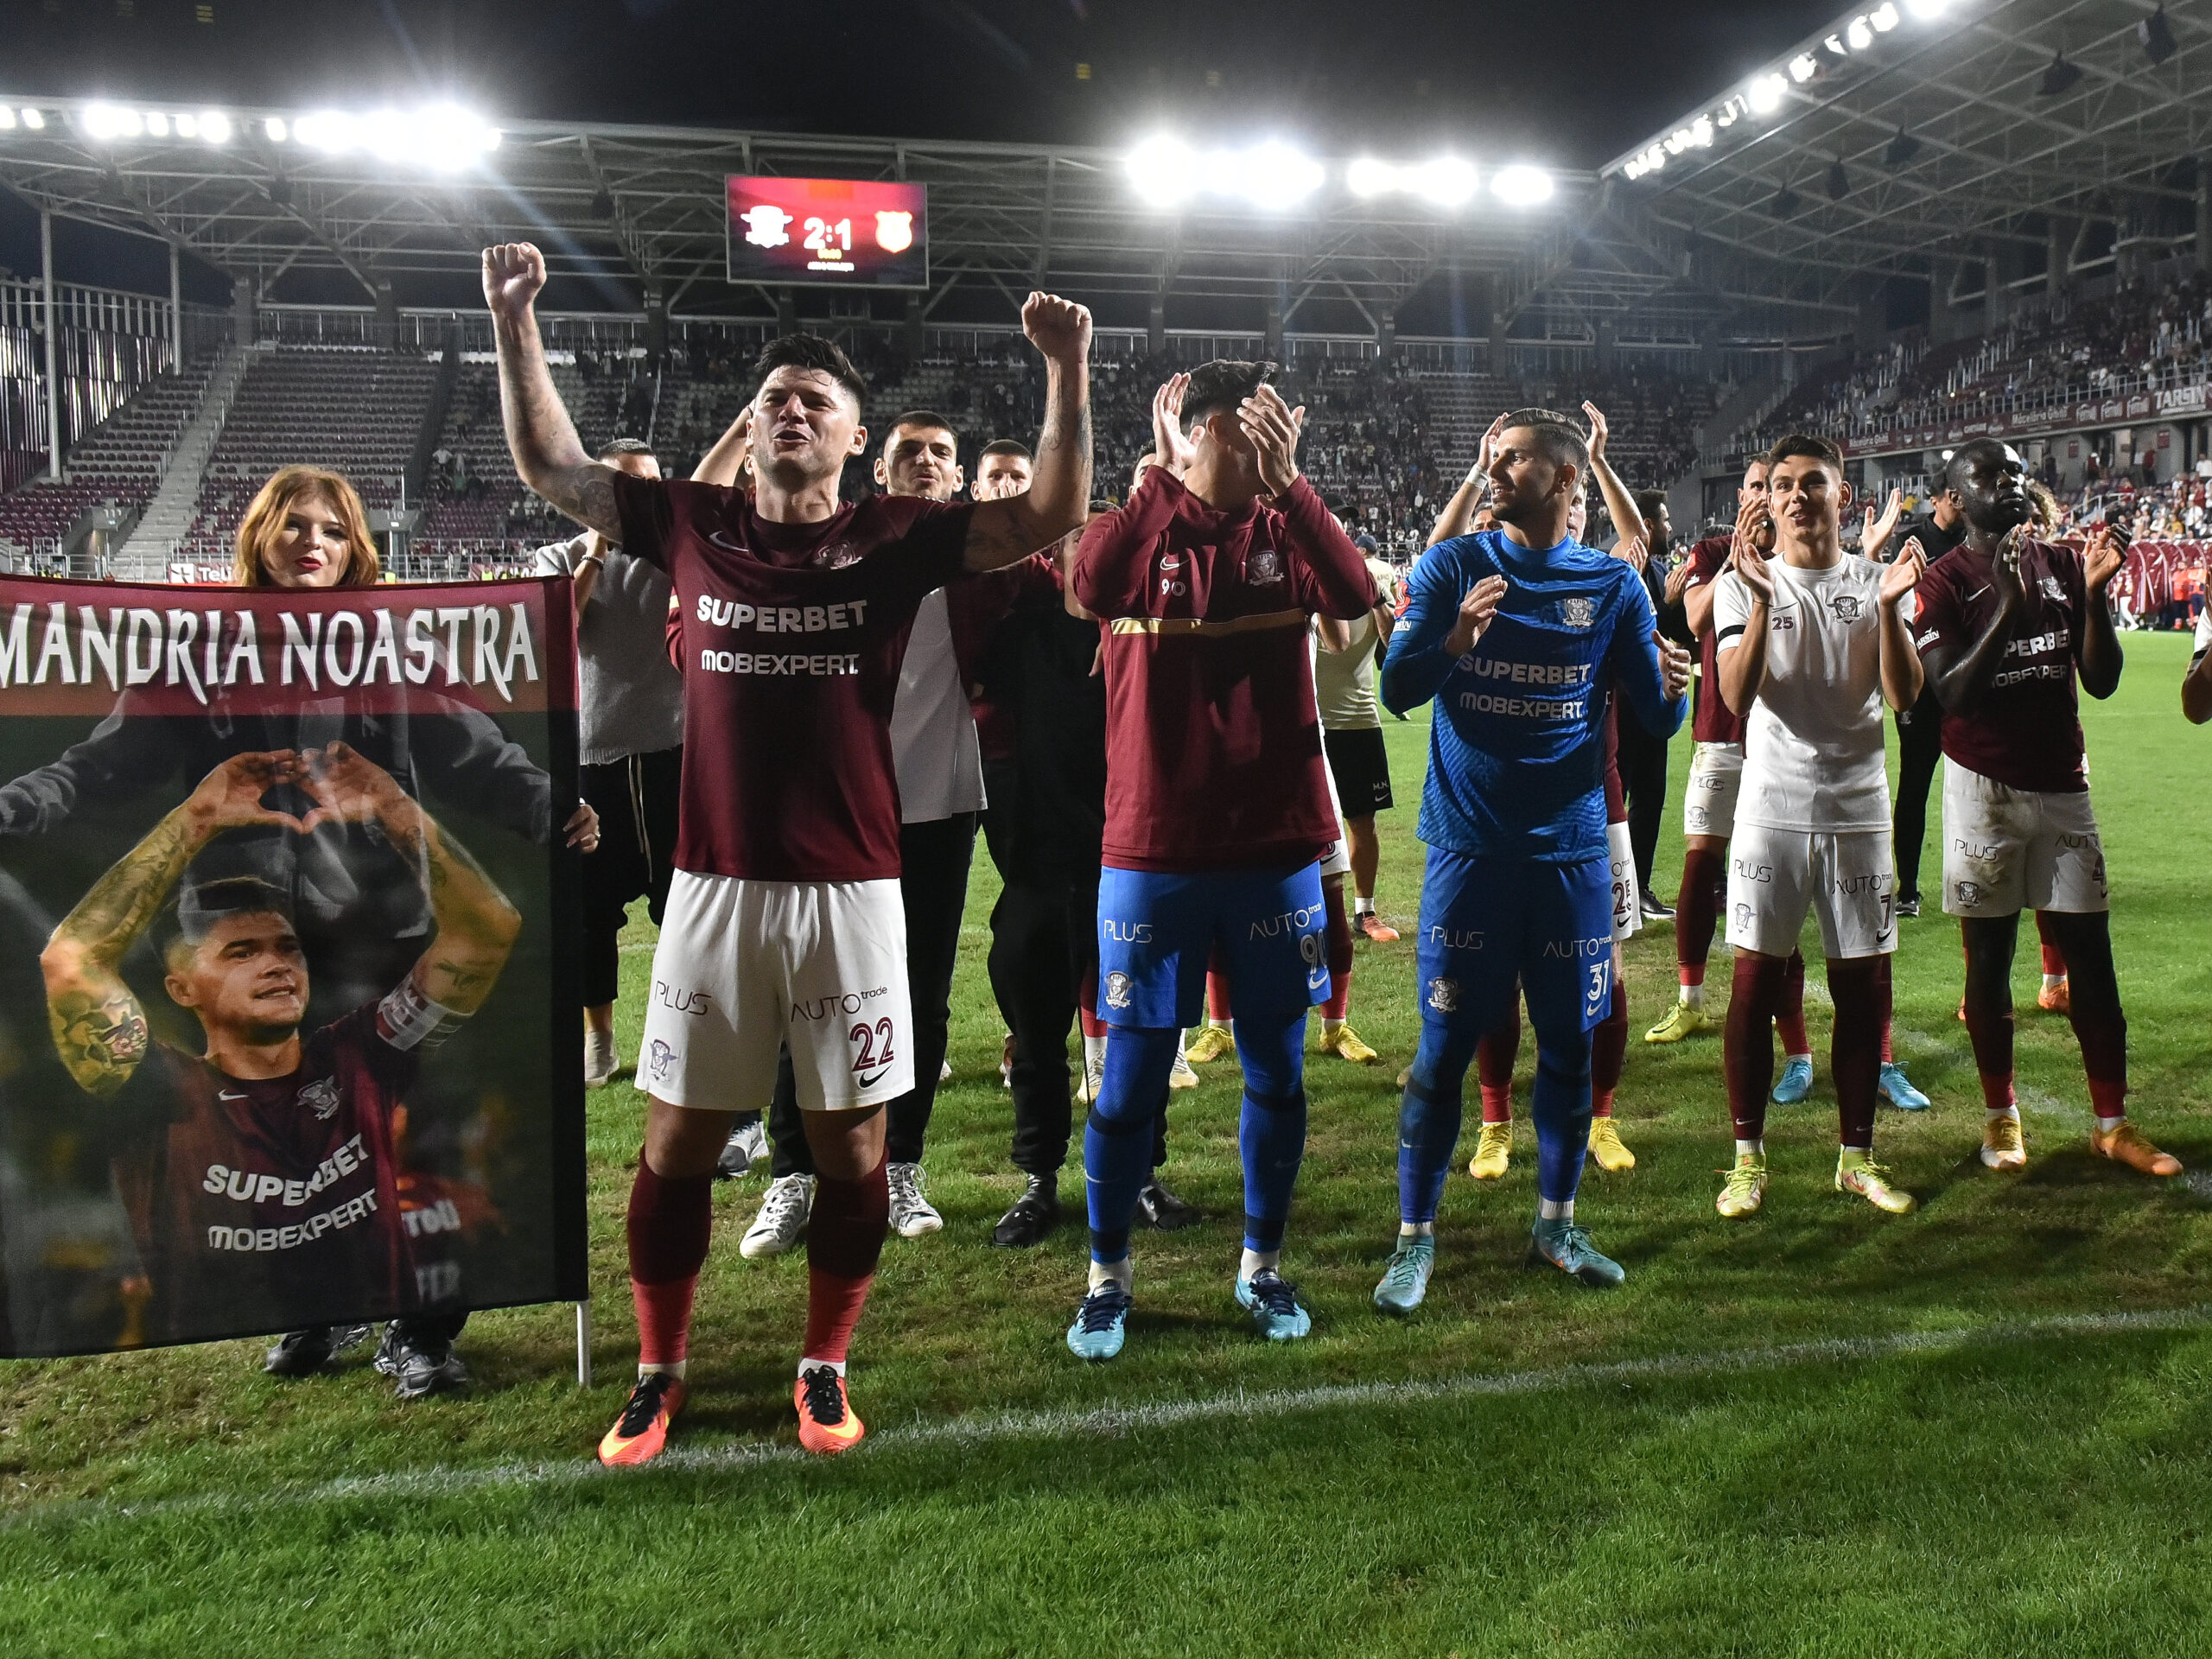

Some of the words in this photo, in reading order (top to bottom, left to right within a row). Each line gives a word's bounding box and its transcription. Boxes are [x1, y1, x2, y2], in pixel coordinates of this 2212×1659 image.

[804, 217, 851, 250] 2:1
[1161, 579, 1185, 596] 90
[697, 594, 867, 632] SUPERBET
[1772, 616, 1794, 630] 25
[277, 601, 538, 703] NOASTRA
[2005, 629, 2070, 658] PERBE
[702, 649, 861, 676] MOBEXPERT
[1459, 653, 1591, 684] SUPERBET
[1460, 691, 1584, 719] MOBEXPERT
[1694, 776, 1725, 791] PLUS
[1955, 838, 1998, 861] PLUS
[1734, 859, 1773, 883] PLUS
[1832, 874, 1881, 895] AUTO
[1250, 909, 1310, 941] AUTO
[1880, 894, 1891, 931] 7
[1104, 919, 1154, 944] PLUS
[1431, 925, 1484, 950] PLUS
[1543, 938, 1599, 958] AUTO
[1587, 959, 1610, 1001] 31
[654, 980, 712, 1016] PLUS
[791, 994, 861, 1023] AUTO
[861, 985, 888, 1000] trade
[849, 1016, 895, 1072] 22
[202, 1133, 370, 1207] SUPERBET
[207, 1188, 378, 1252] MOBEXPERT
